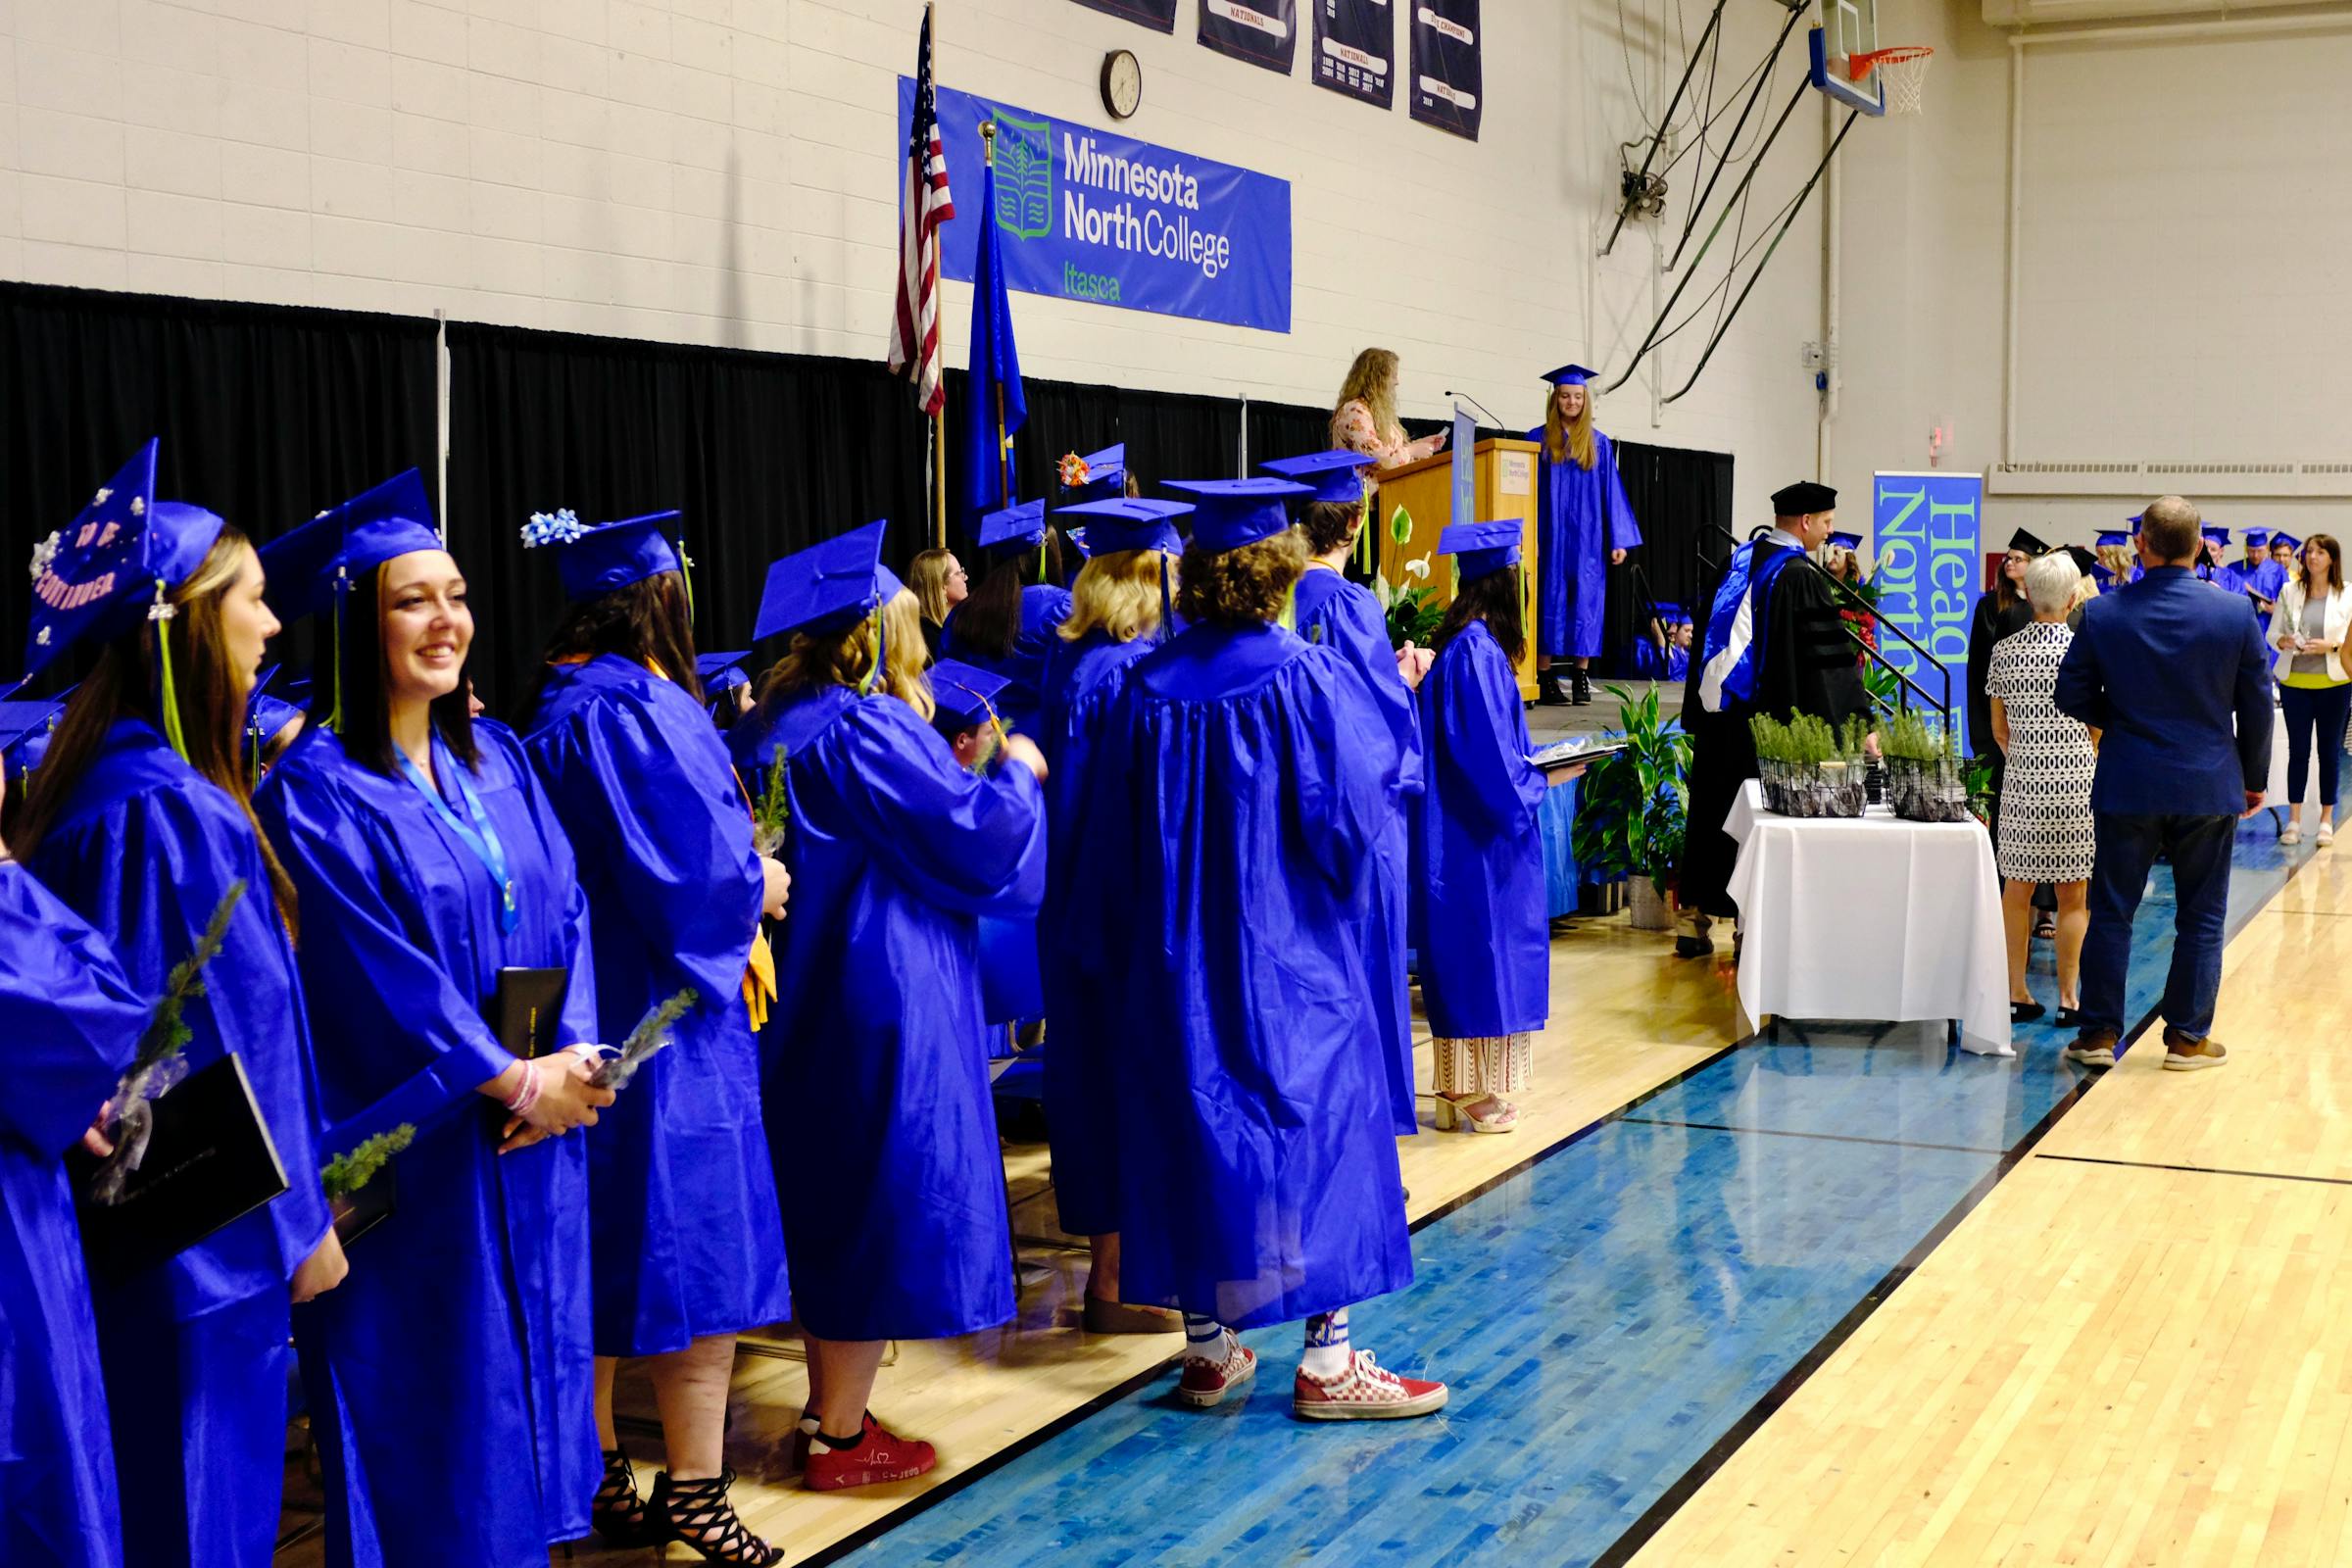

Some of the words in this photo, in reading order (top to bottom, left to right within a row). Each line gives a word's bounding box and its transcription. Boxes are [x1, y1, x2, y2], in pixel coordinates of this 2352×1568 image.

[1230, 7, 1264, 26] NATIONALS
[1064, 131, 1200, 211] Minnesota
[1063, 260, 1121, 302] Itasca
[1879, 484, 1931, 678] North
[1930, 495, 1976, 671] Head
